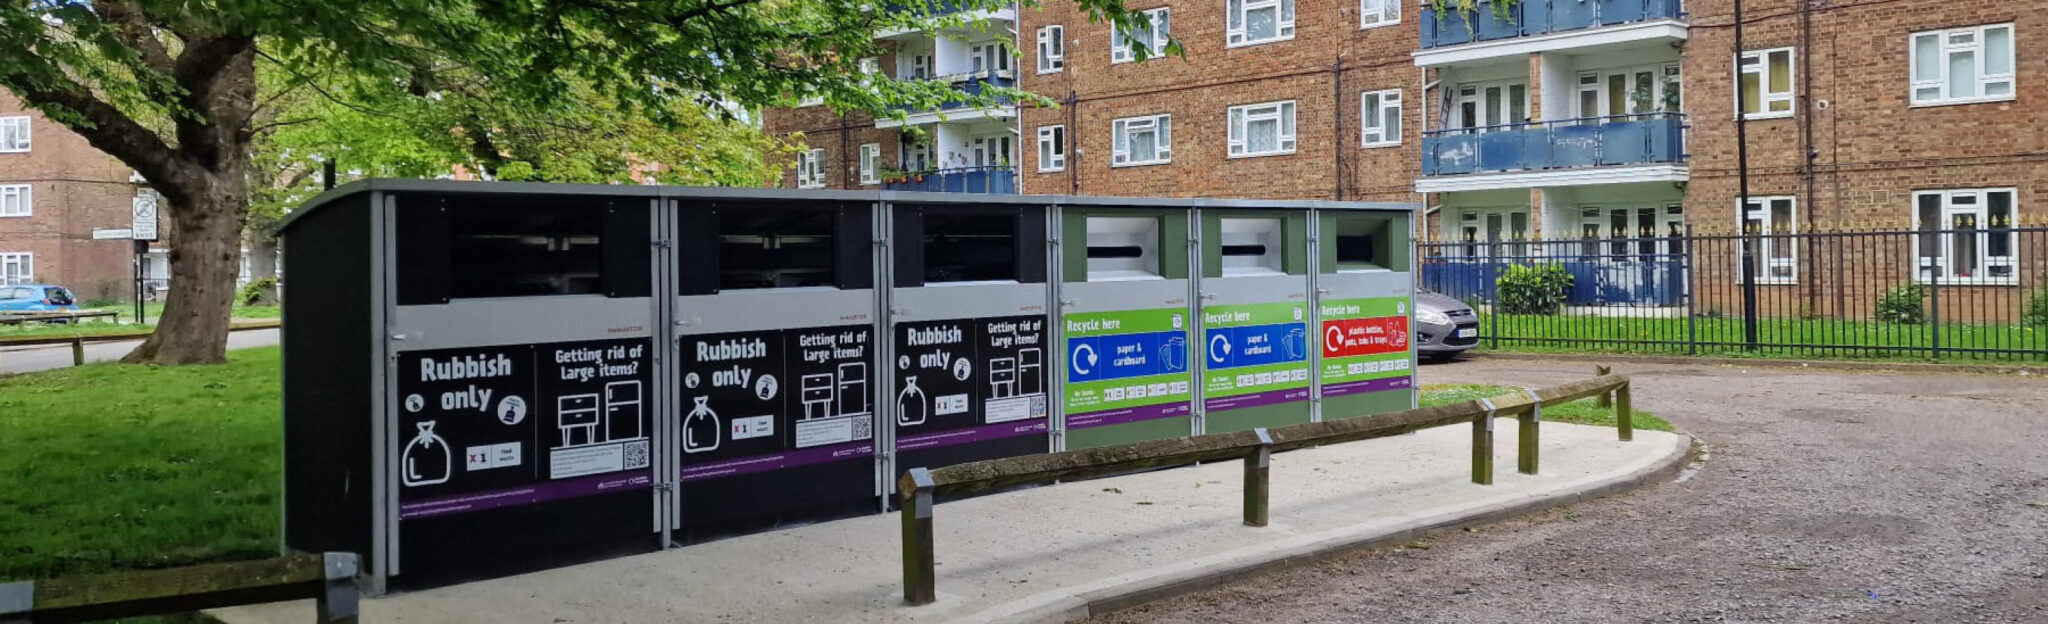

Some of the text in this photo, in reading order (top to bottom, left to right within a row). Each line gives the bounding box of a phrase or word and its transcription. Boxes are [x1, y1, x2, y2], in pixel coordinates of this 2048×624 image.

[1067, 318, 1121, 333] Recycle here
[1205, 311, 1250, 324] Recycle here
[907, 325, 962, 346] Rubbish
[988, 320, 1041, 335] Getting rid of
[800, 331, 867, 348] Getting rid of
[555, 344, 643, 364] Getting rid of
[697, 338, 766, 362] Rubbish
[833, 346, 864, 359] items?
[1117, 342, 1142, 355] paper &
[421, 353, 511, 382] Rubbish
[920, 348, 951, 371] only
[1113, 355, 1146, 367] cardboard
[599, 361, 639, 377] items?
[712, 364, 752, 389] only
[441, 385, 492, 412] only
